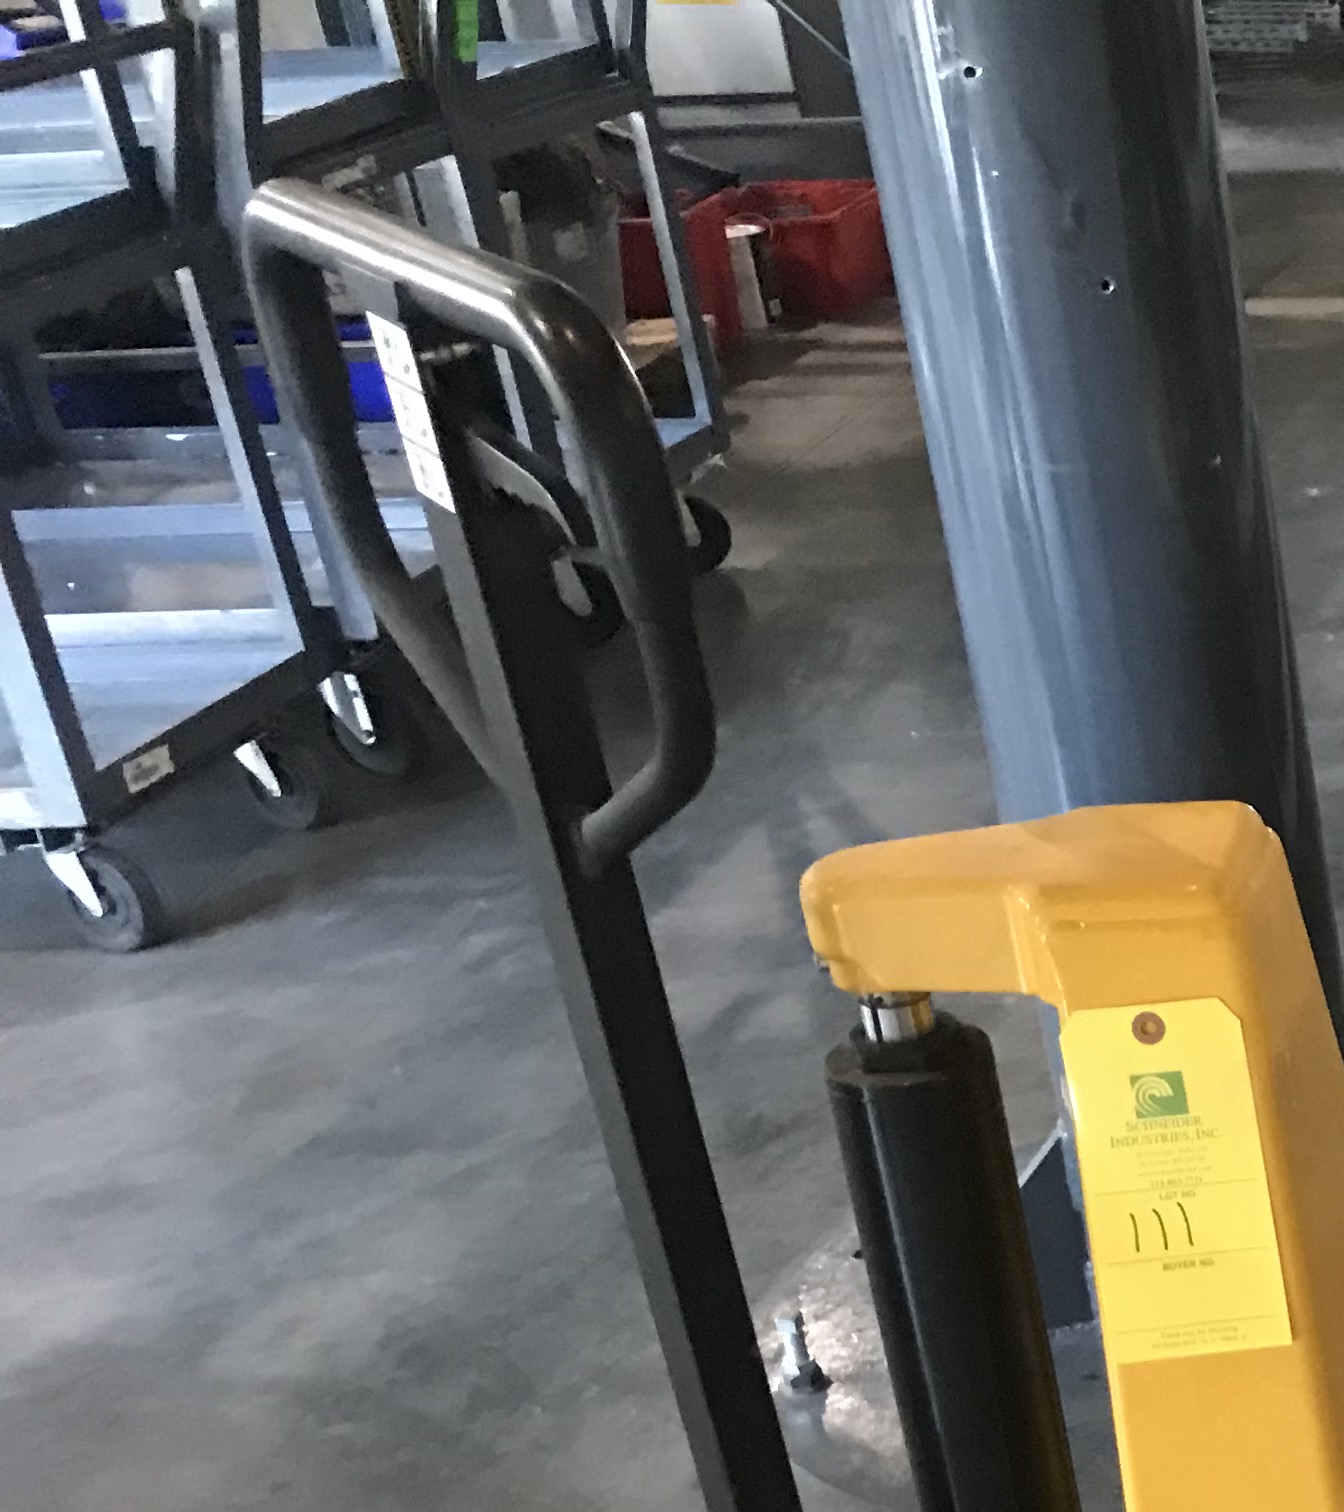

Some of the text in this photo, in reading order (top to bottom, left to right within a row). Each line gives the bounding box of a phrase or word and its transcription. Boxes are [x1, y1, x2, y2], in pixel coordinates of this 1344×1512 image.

[1125, 1115, 1203, 1132] SCHNEIDER
[1158, 1190, 1178, 1201] LOT
[1128, 1201, 1195, 1253] 111
[1162, 1259, 1197, 1272] BUYER
